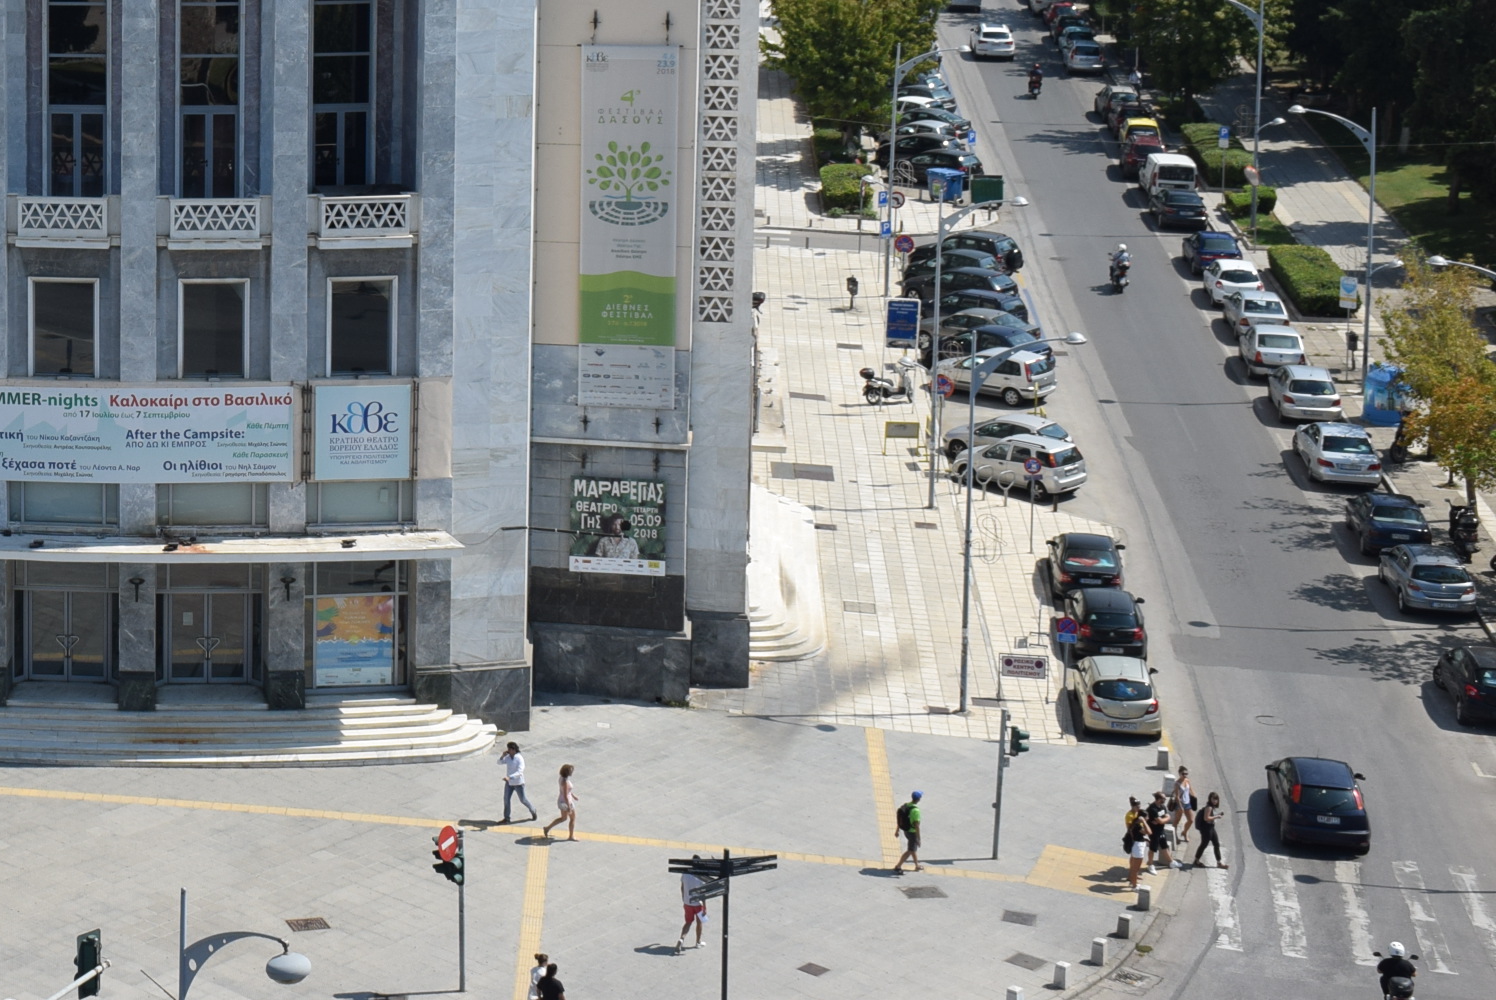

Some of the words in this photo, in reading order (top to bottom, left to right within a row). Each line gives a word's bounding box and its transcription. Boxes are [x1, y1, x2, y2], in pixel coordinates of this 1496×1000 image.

[598, 116, 663, 124] ΔΑΣΟΥΣ
[110, 393, 188, 410] Καλοκαίρι
[192, 395, 220, 406] στο
[224, 392, 292, 406] Βασιλικό
[79, 410, 90, 418] 17
[92, 411, 119, 419] Ιουλίου
[121, 411, 134, 419] έως
[143, 411, 190, 419] Σεπτεμβρίου
[60, 434, 100, 442] Καζαντζάκη
[126, 429, 157, 440] After
[160, 429, 181, 439] the
[184, 429, 245, 441] Campsite:
[172, 440, 207, 448] ΕΜΠΡΟΣ
[250, 451, 289, 459] Παρασκευή
[2, 458, 45, 471] ξέχασα
[48, 459, 77, 470] ποτέ
[163, 460, 177, 471] Οι
[180, 460, 222, 474] ηλίθιοι
[574, 479, 664, 504] ΜΑΡΑΒΕΓΙΑΣ
[576, 501, 618, 513] ΘΕΑΤΡΟ
[581, 513, 601, 529] ΓΗΣ
[630, 514, 661, 526] 05.09
[634, 529, 658, 539] 2018
